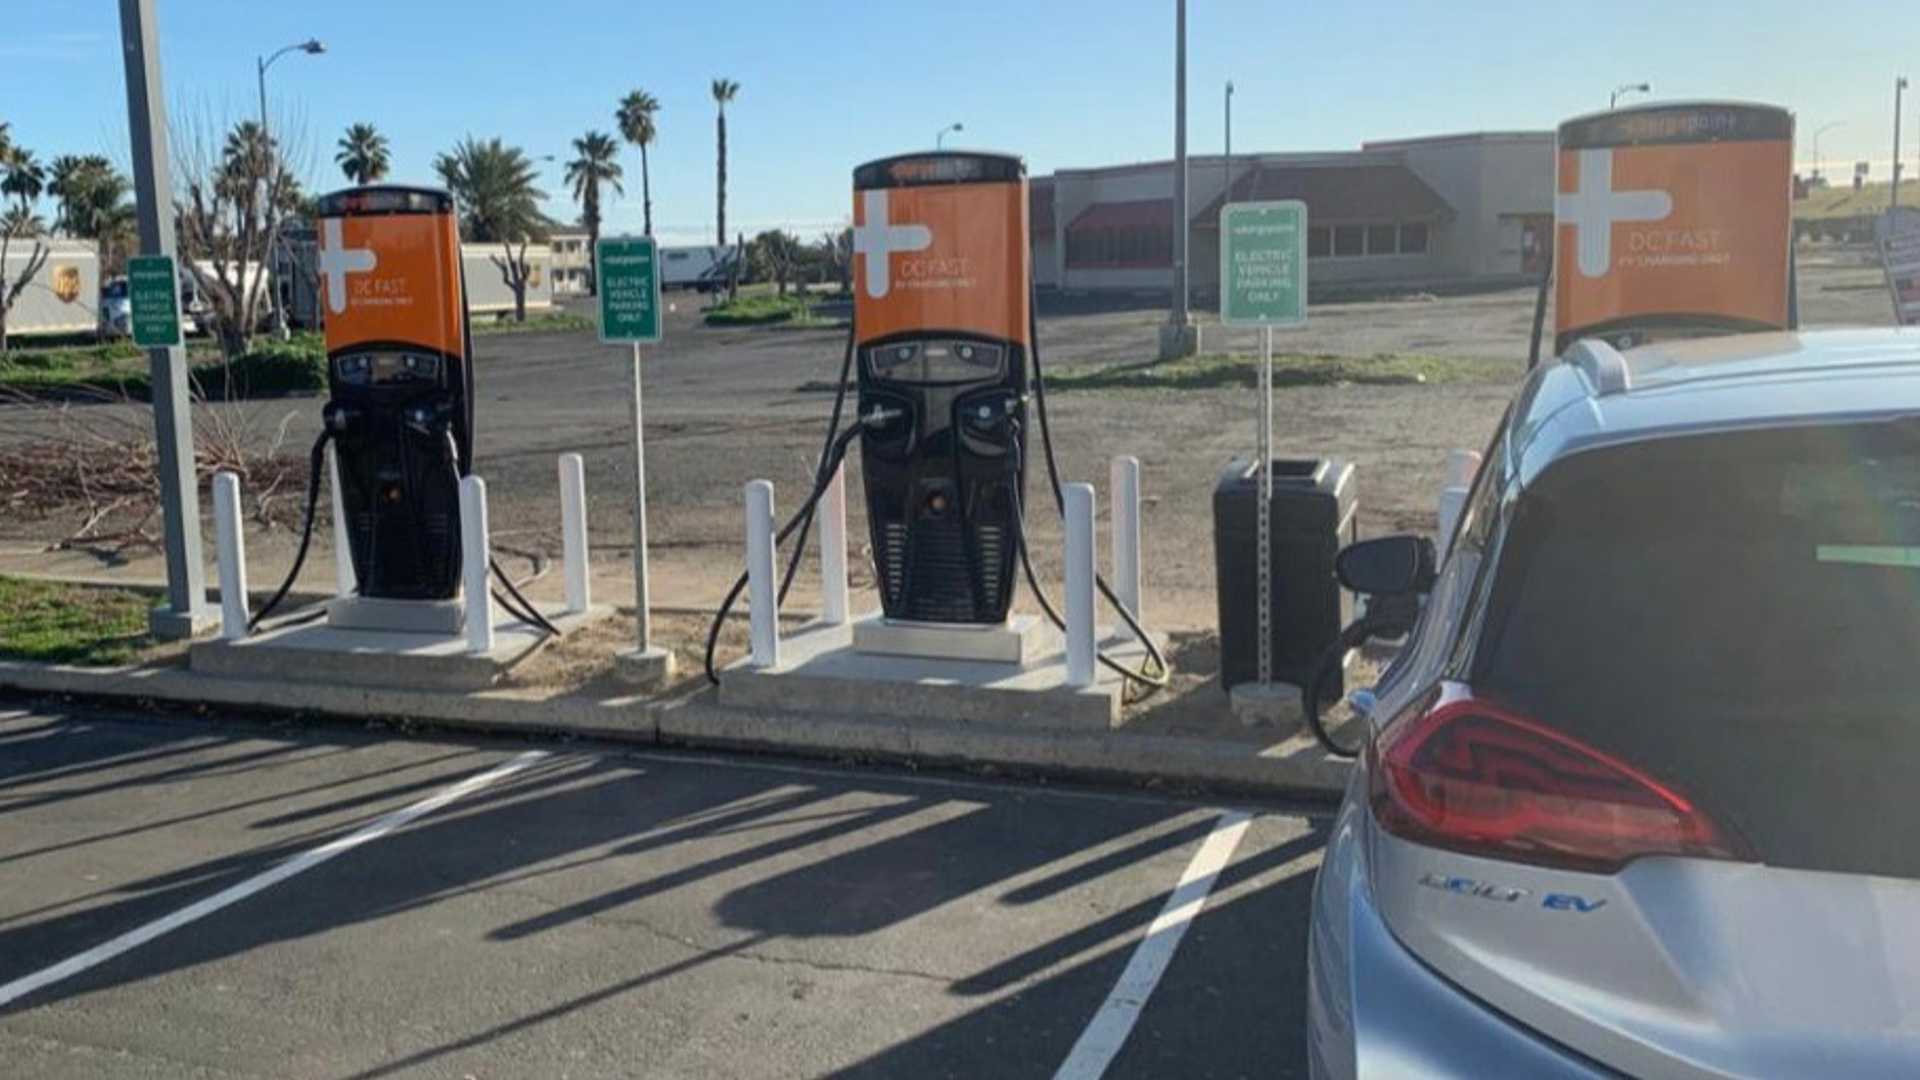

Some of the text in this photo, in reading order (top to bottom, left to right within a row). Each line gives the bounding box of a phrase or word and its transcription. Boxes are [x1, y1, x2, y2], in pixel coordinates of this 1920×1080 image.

[1630, 230, 1720, 251] DC FAST
[1247, 291, 1279, 303] ONLY
[1542, 892, 1607, 912] EV
